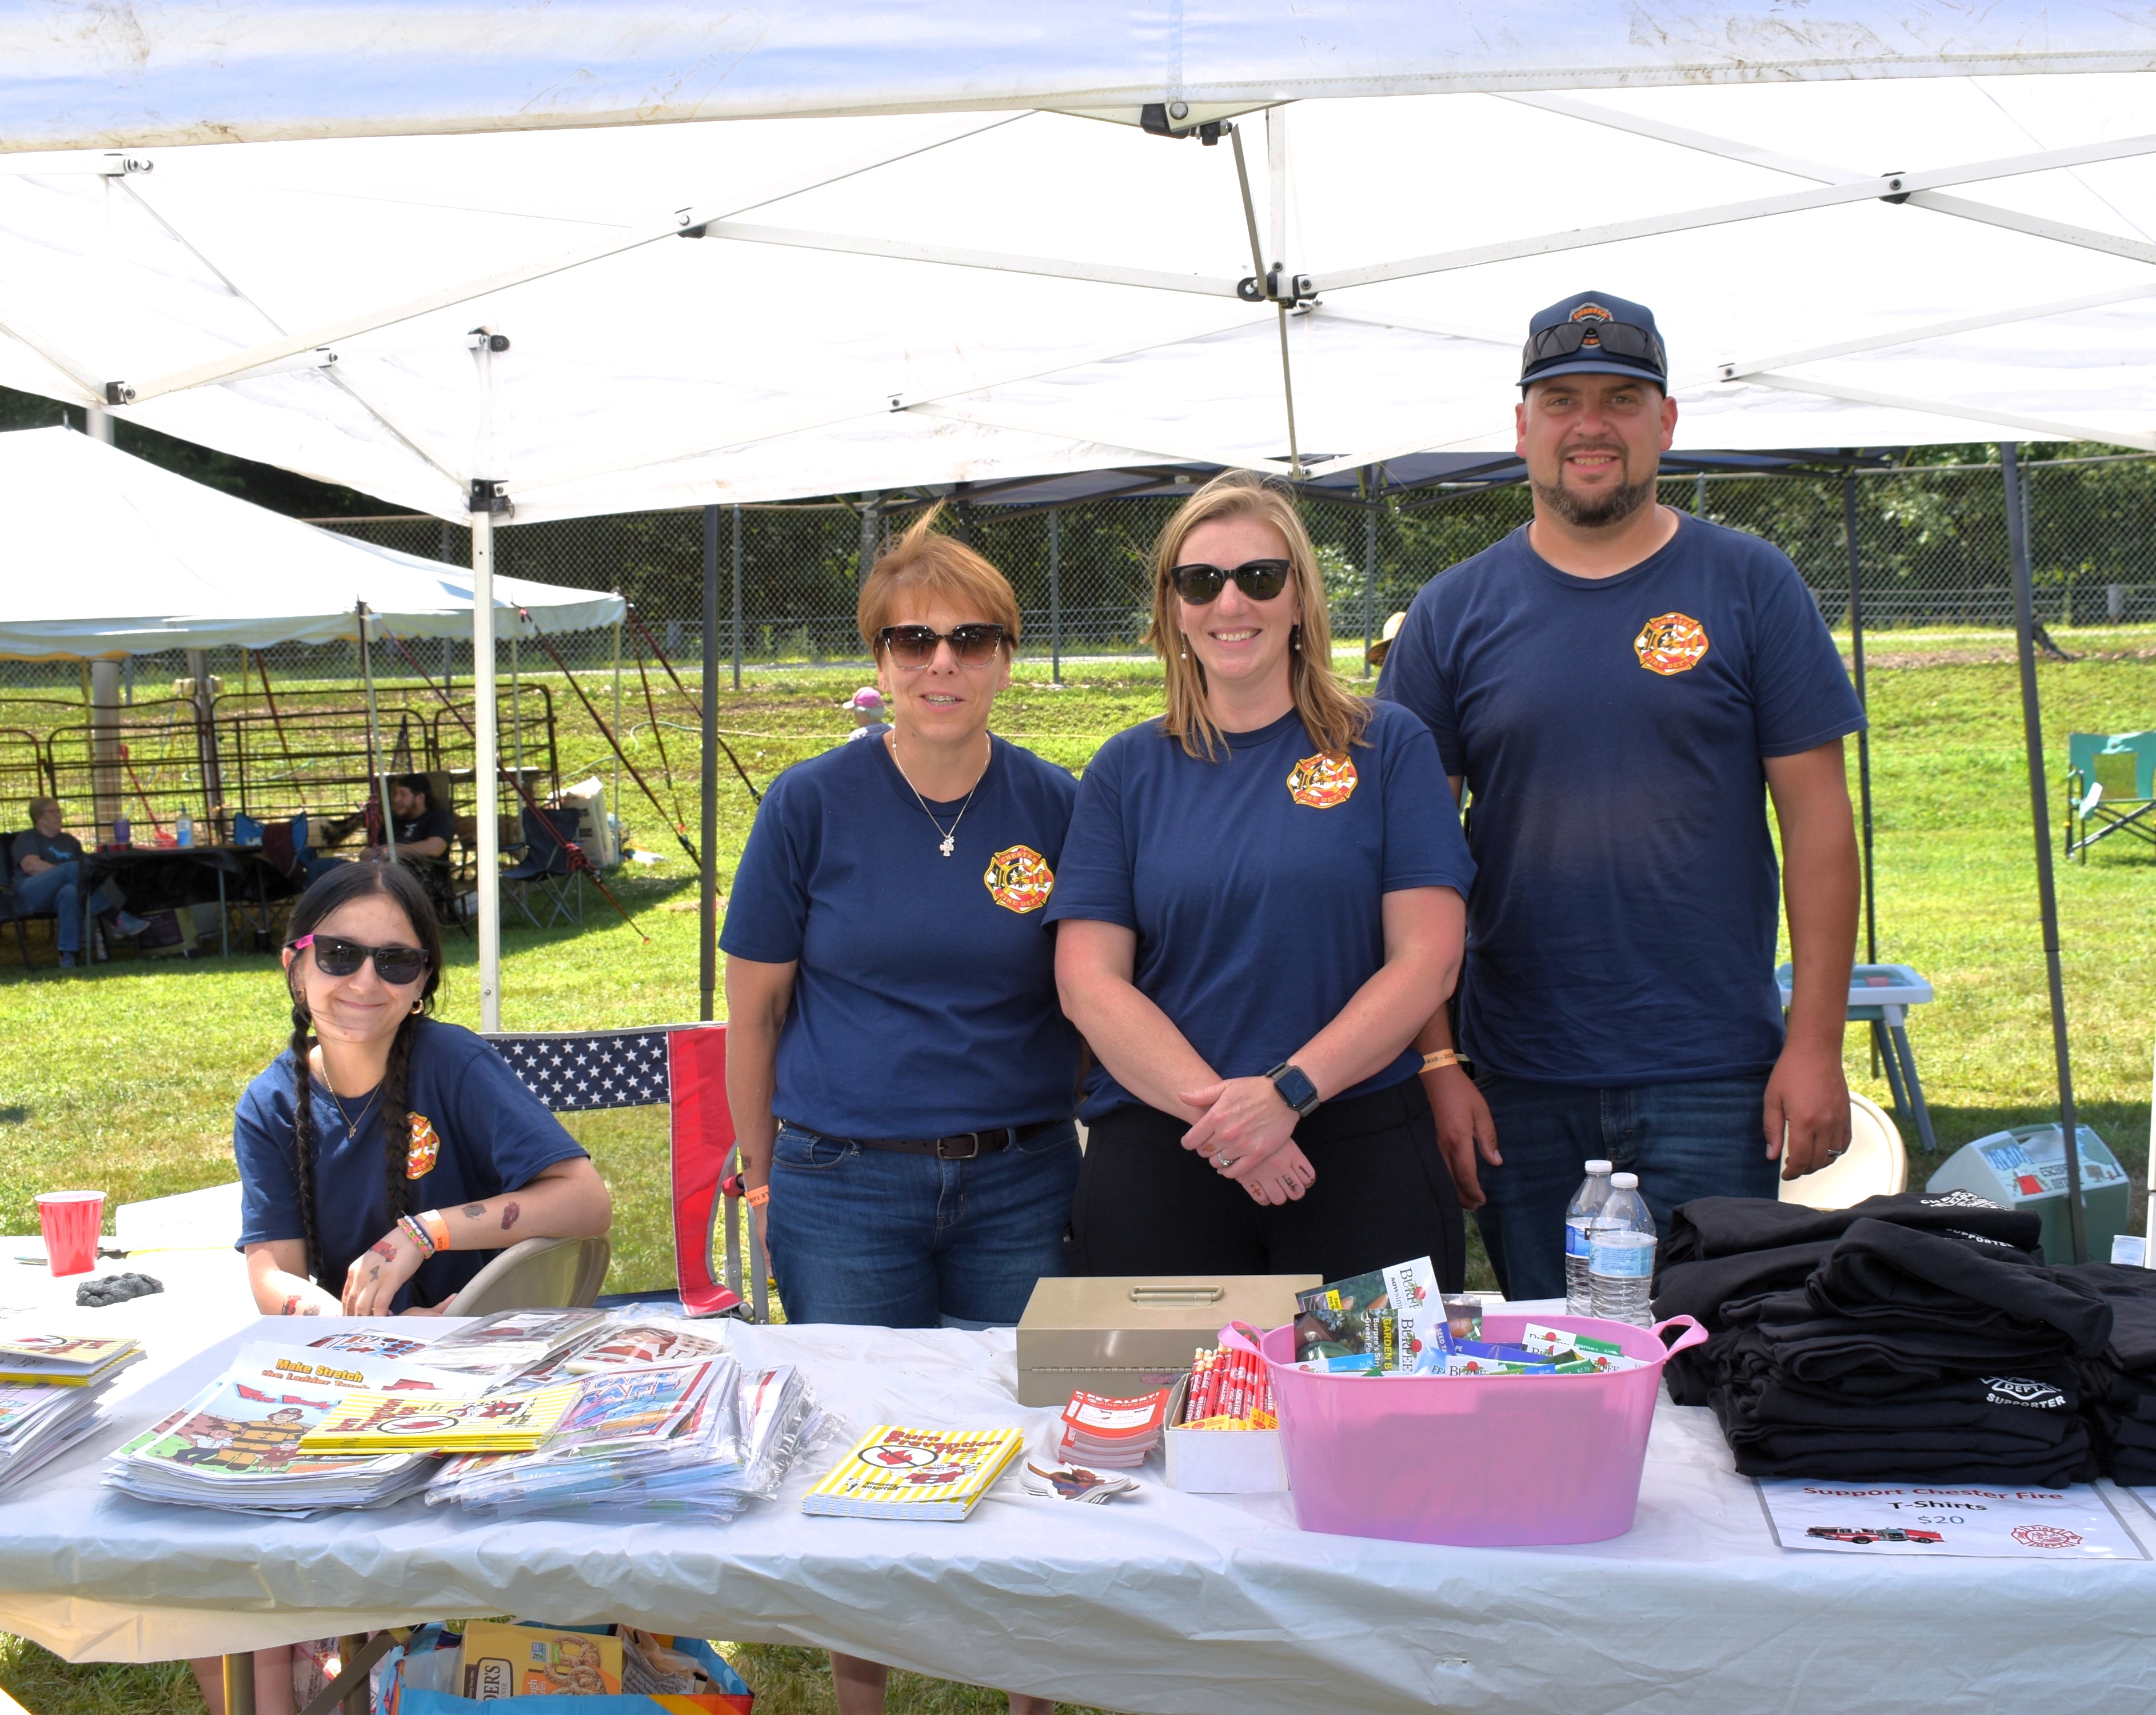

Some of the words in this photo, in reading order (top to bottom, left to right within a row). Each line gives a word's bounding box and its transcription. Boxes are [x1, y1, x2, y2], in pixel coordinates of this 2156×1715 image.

[1655, 618, 1693, 629] CHESTER
[1646, 656, 1664, 668] FIRE
[1300, 792, 1319, 801] FIRE
[1001, 852, 1038, 863] CHESTER
[1000, 893, 1018, 906] FIRE
[1021, 895, 1041, 907] DEPT.
[1383, 1318, 1393, 1359] GARDEN
[1436, 1327, 1445, 1344] SEED
[1401, 1318, 1414, 1371] BURPEE
[275, 1358, 313, 1373] Make
[314, 1365, 364, 1383] Stretch
[286, 1373, 331, 1386] Ladder
[594, 1373, 650, 1389] CAN
[652, 1372, 688, 1383] BE
[581, 1378, 682, 1403] SAFE
[2003, 1383, 2046, 1393] DEPT.
[1087, 1393, 1112, 1403] PET
[1112, 1391, 1160, 1404] ALERT!
[1233, 1389, 1243, 1415] CHESTER
[1986, 1393, 2066, 1409] SUPPORTER
[344, 1398, 405, 1432] Prevention
[325, 1418, 362, 1432] Burn
[883, 1435, 1003, 1449] Prevention
[888, 1430, 941, 1441] Burn
[934, 1444, 979, 1455] Tips
[1803, 1487, 1906, 1497] Support
[1912, 1488, 2008, 1499] Chester
[2015, 1491, 2065, 1500] Fire
[1887, 1501, 1988, 1511] T-Shirts
[1917, 1515, 1965, 1525] $20
